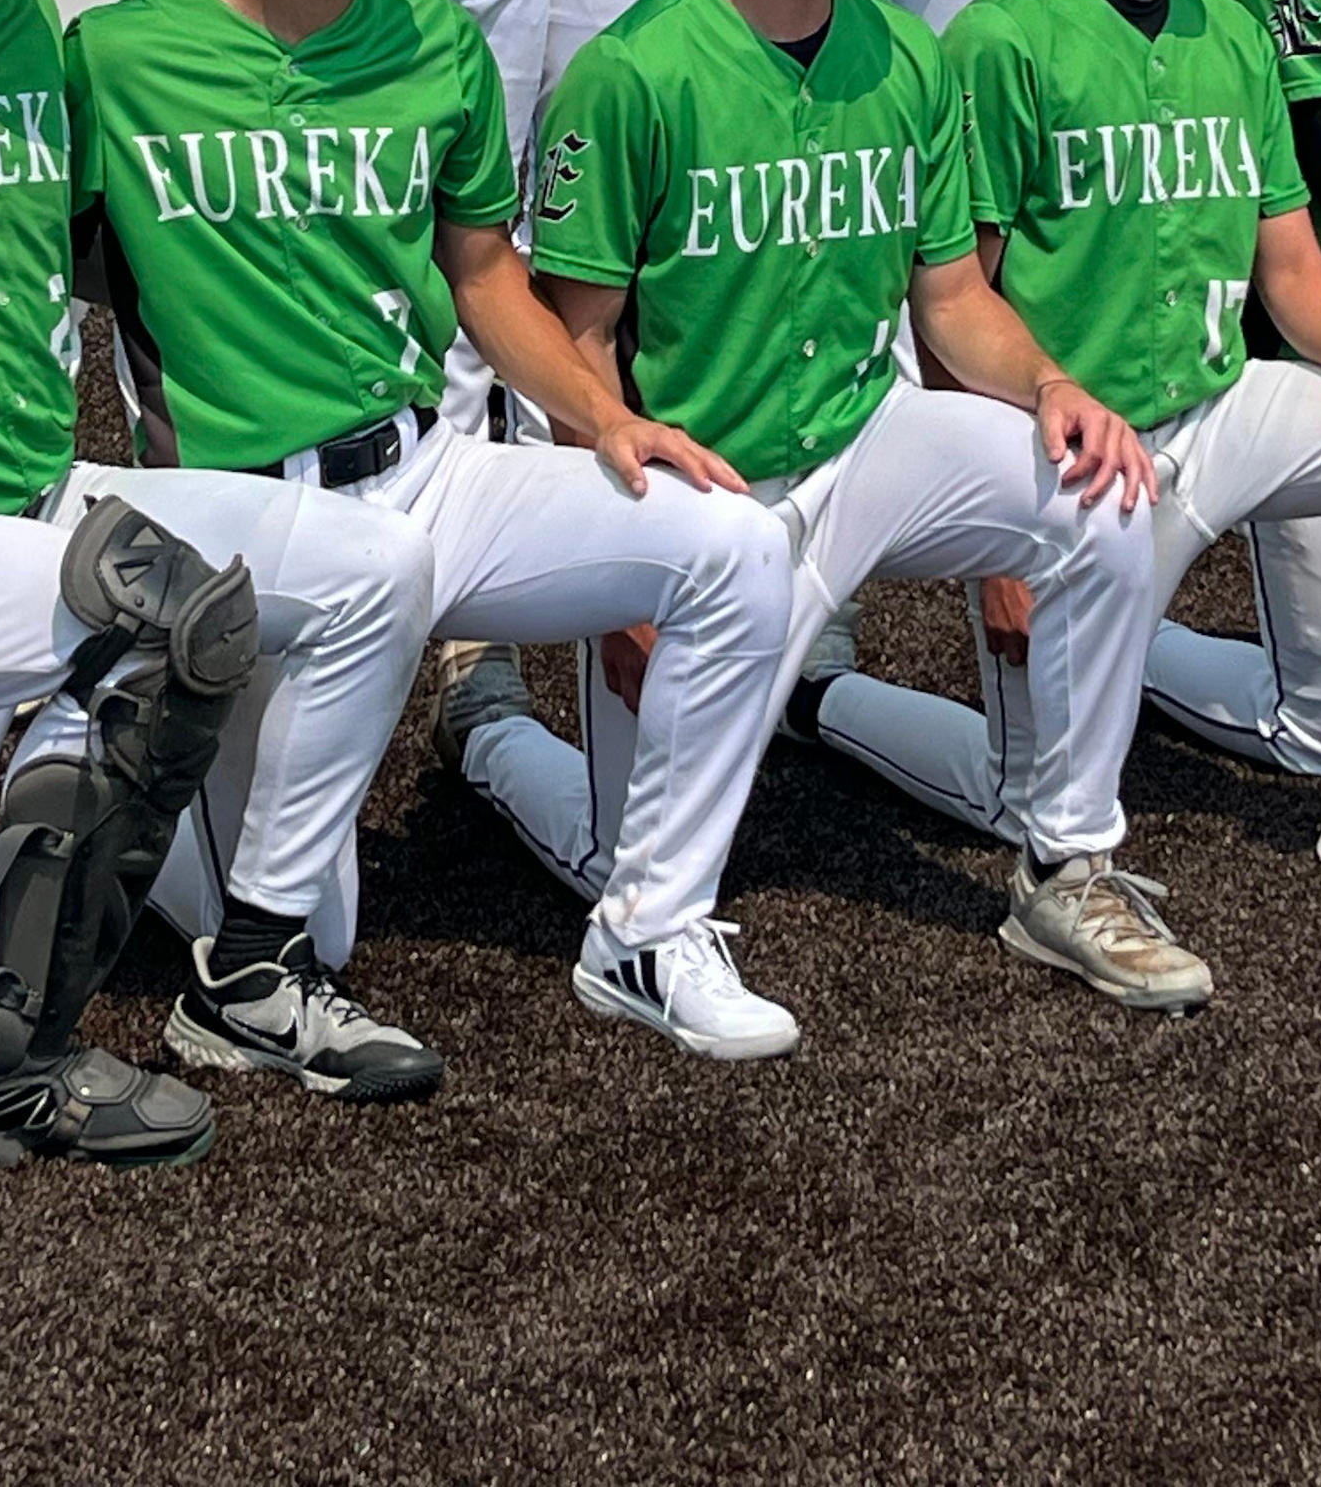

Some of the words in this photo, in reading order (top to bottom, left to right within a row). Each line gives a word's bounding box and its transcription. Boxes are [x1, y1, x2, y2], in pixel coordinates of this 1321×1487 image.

[132, 126, 430, 222] EUREKA
[681, 145, 918, 257] EUREKA
[1053, 116, 1262, 210] EUREKA
